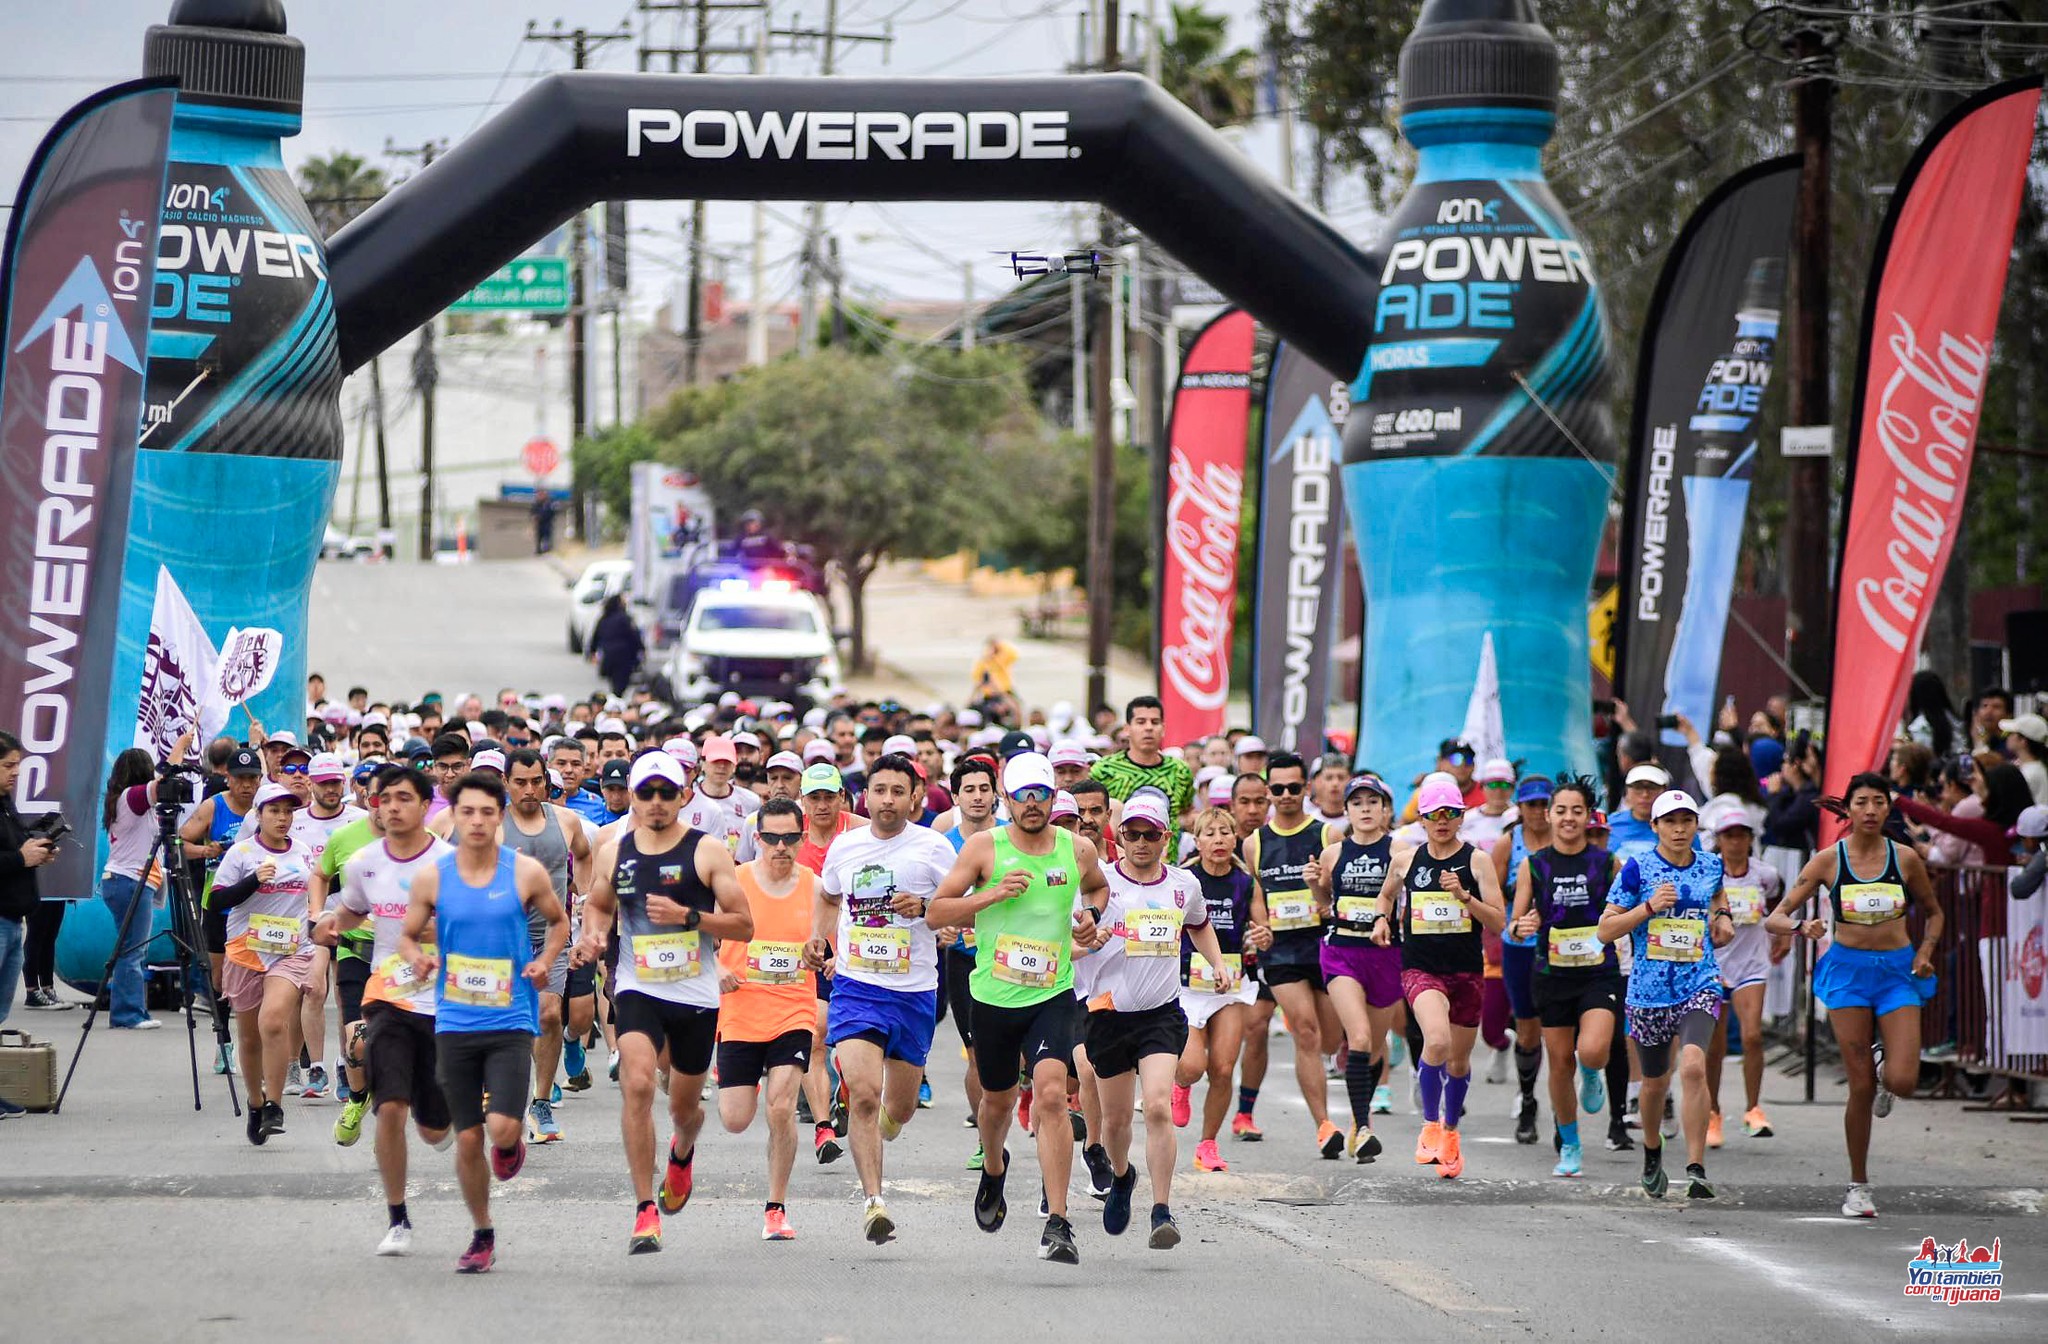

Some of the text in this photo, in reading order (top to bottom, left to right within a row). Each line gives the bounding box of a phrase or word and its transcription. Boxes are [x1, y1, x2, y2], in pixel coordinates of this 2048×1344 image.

[627, 108, 1071, 160] POWERADE
[163, 211, 264, 225] TASIO CALCIO MAGNESIO
[157, 225, 328, 280] OWER
[1380, 236, 1597, 286] POWER
[152, 272, 231, 323] DE
[1374, 281, 1516, 334] ADE
[1372, 346, 1429, 370] MORAS
[1696, 383, 1764, 413] ADE
[1395, 406, 1462, 433] 600 ml
[1856, 311, 1987, 653] Coca-Cola
[1638, 423, 1677, 622] POWERADE
[15, 317, 108, 815] POWERADE
[1162, 444, 1243, 711] Coca-Cola
[1434, 907, 1448, 916] 03
[1868, 898, 1880, 907] 01
[266, 930, 284, 940] 449
[1150, 927, 1168, 937] 227
[1669, 935, 1689, 945] 342
[867, 945, 888, 955] 426
[1569, 942, 1583, 951] 05
[659, 952, 675, 962] 09
[770, 958, 789, 968] 285
[1021, 956, 1037, 967] 08
[465, 976, 486, 987] 466
